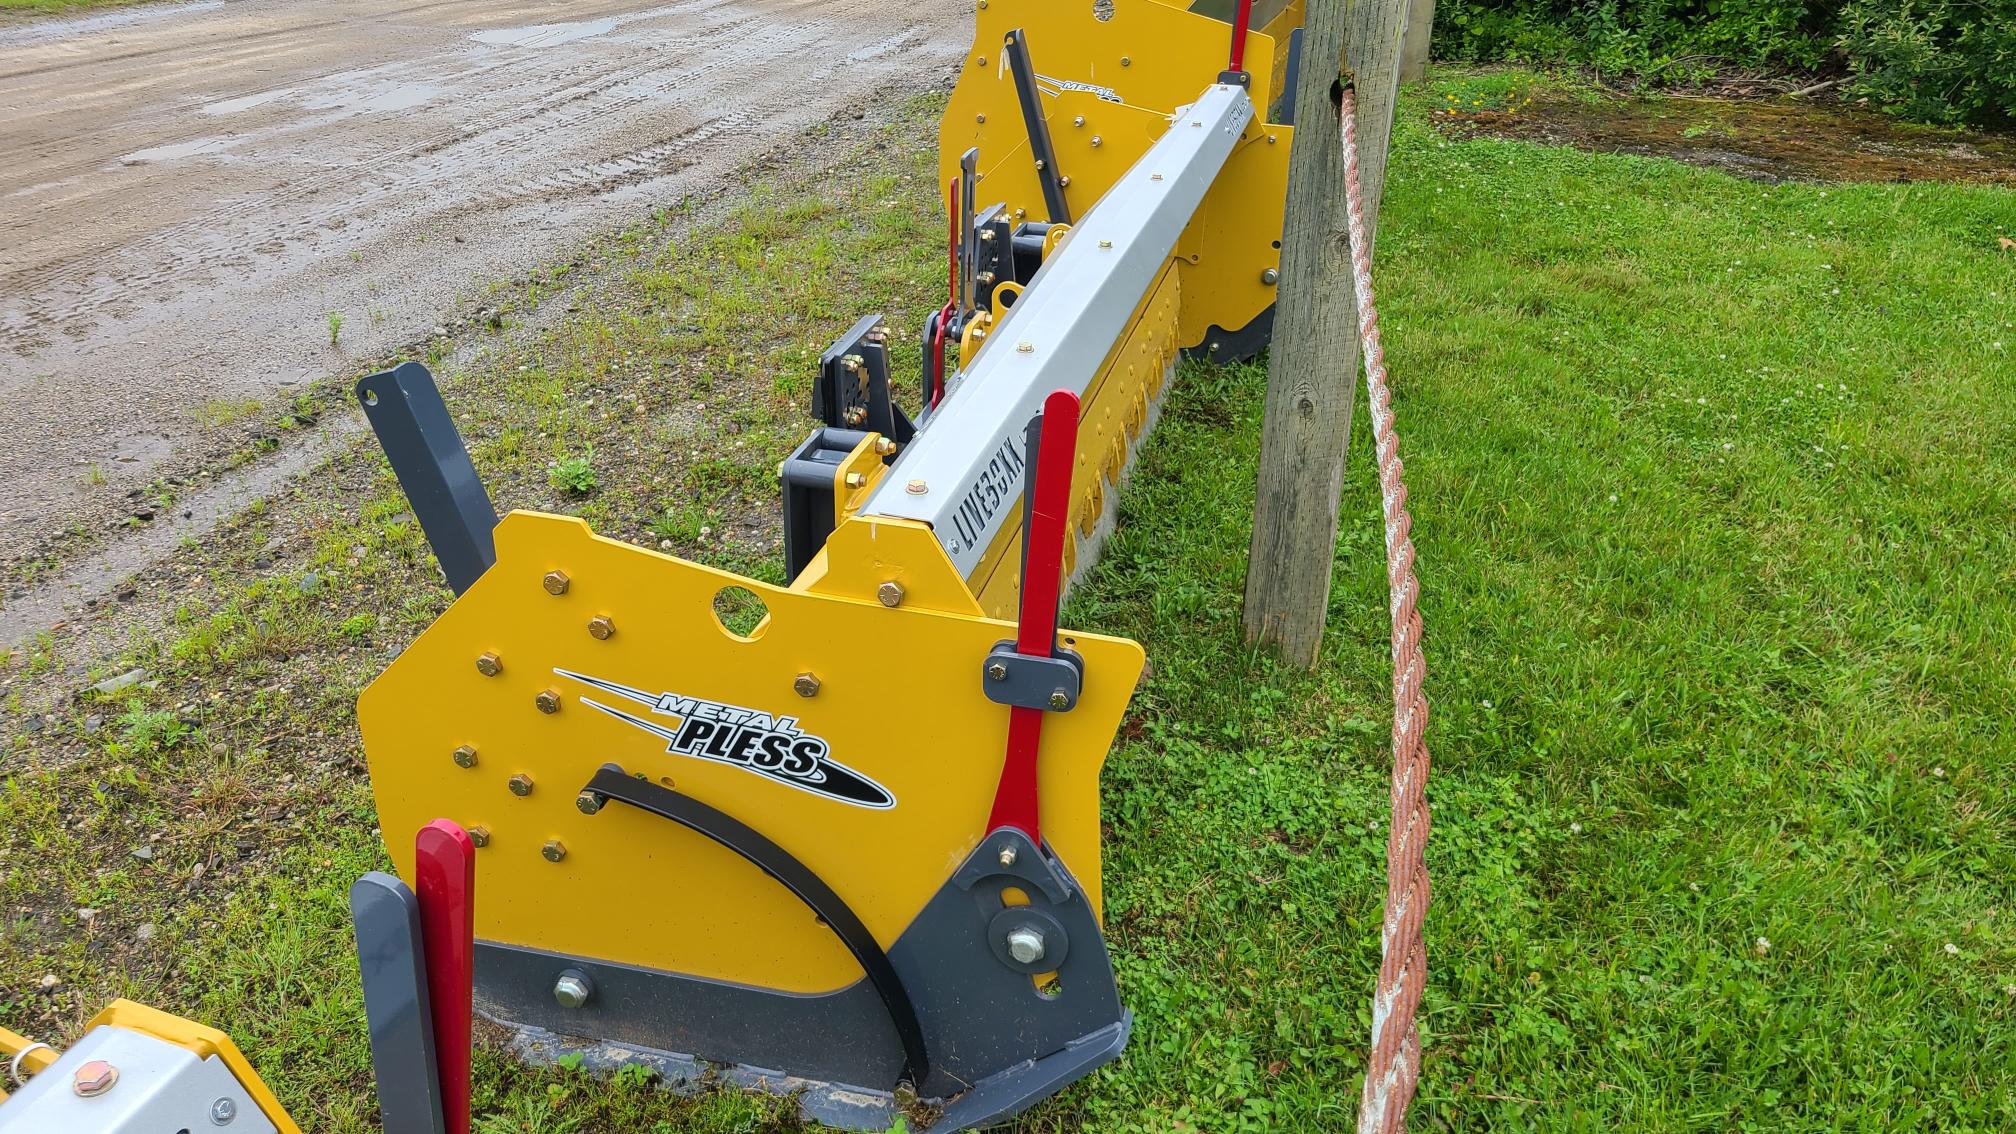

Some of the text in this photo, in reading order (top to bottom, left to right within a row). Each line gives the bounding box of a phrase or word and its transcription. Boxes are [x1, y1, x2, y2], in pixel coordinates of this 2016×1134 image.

[1062, 82, 1114, 97] METAL
[657, 695, 803, 736] METAL
[675, 718, 825, 776] PLESS
